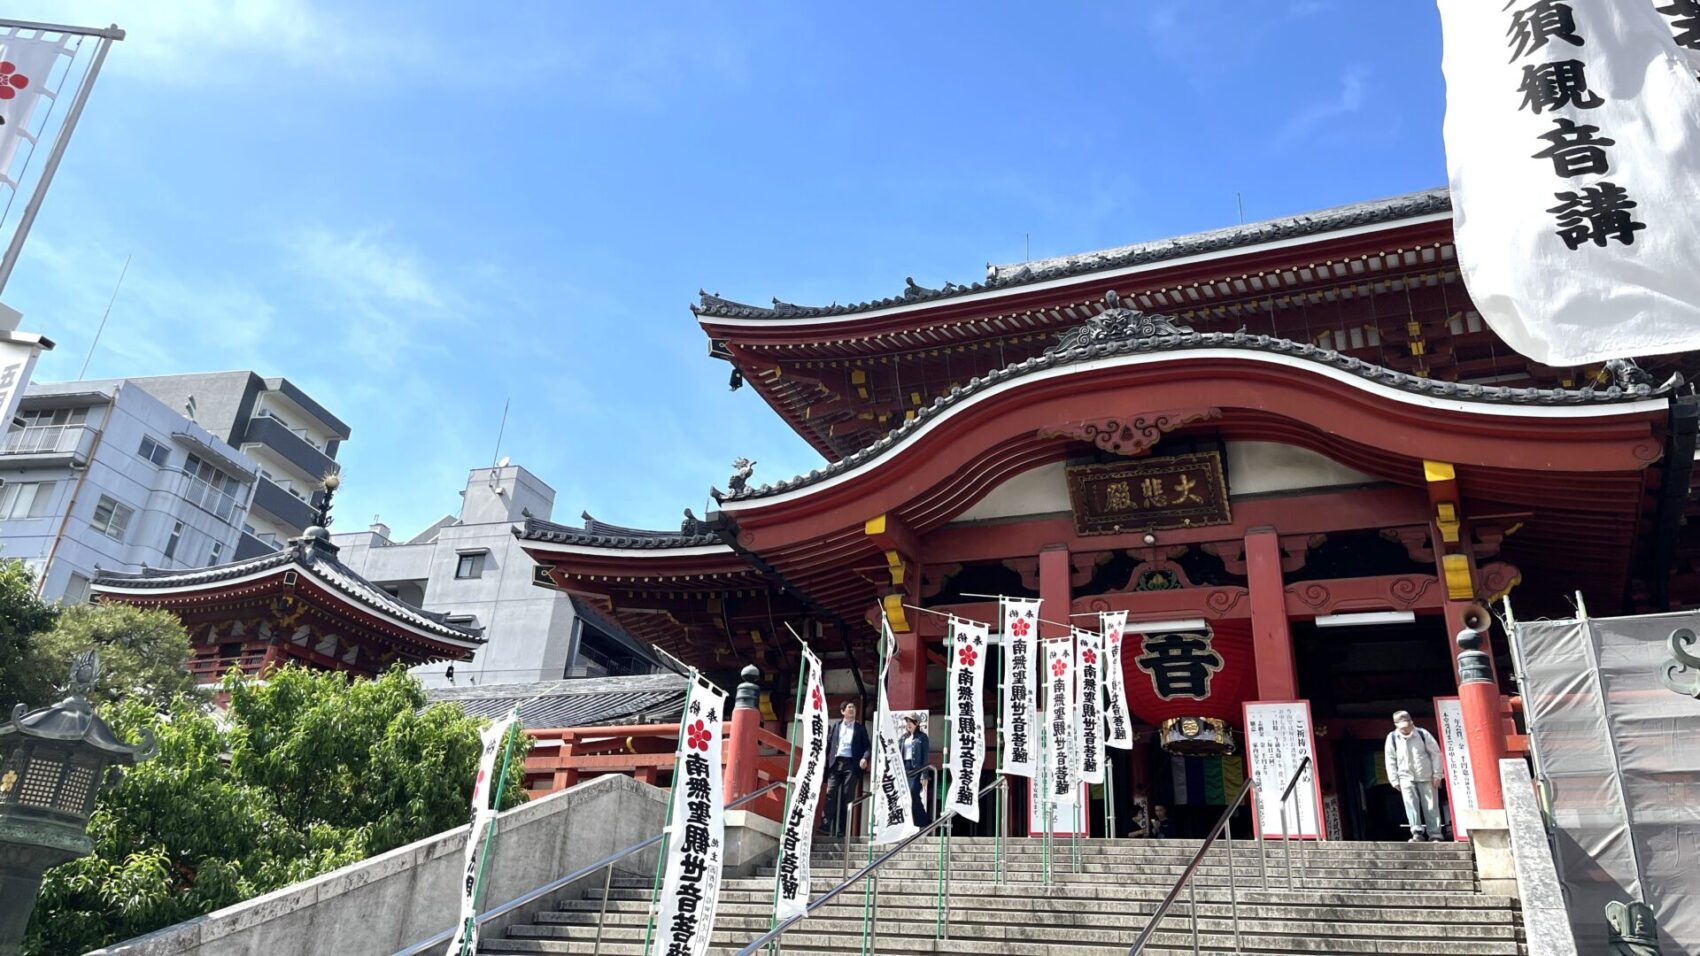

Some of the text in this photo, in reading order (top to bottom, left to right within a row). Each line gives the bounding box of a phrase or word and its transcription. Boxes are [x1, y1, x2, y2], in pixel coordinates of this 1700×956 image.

[1503, 0, 1647, 250] 須観音講
[1135, 622, 1224, 700] 音
